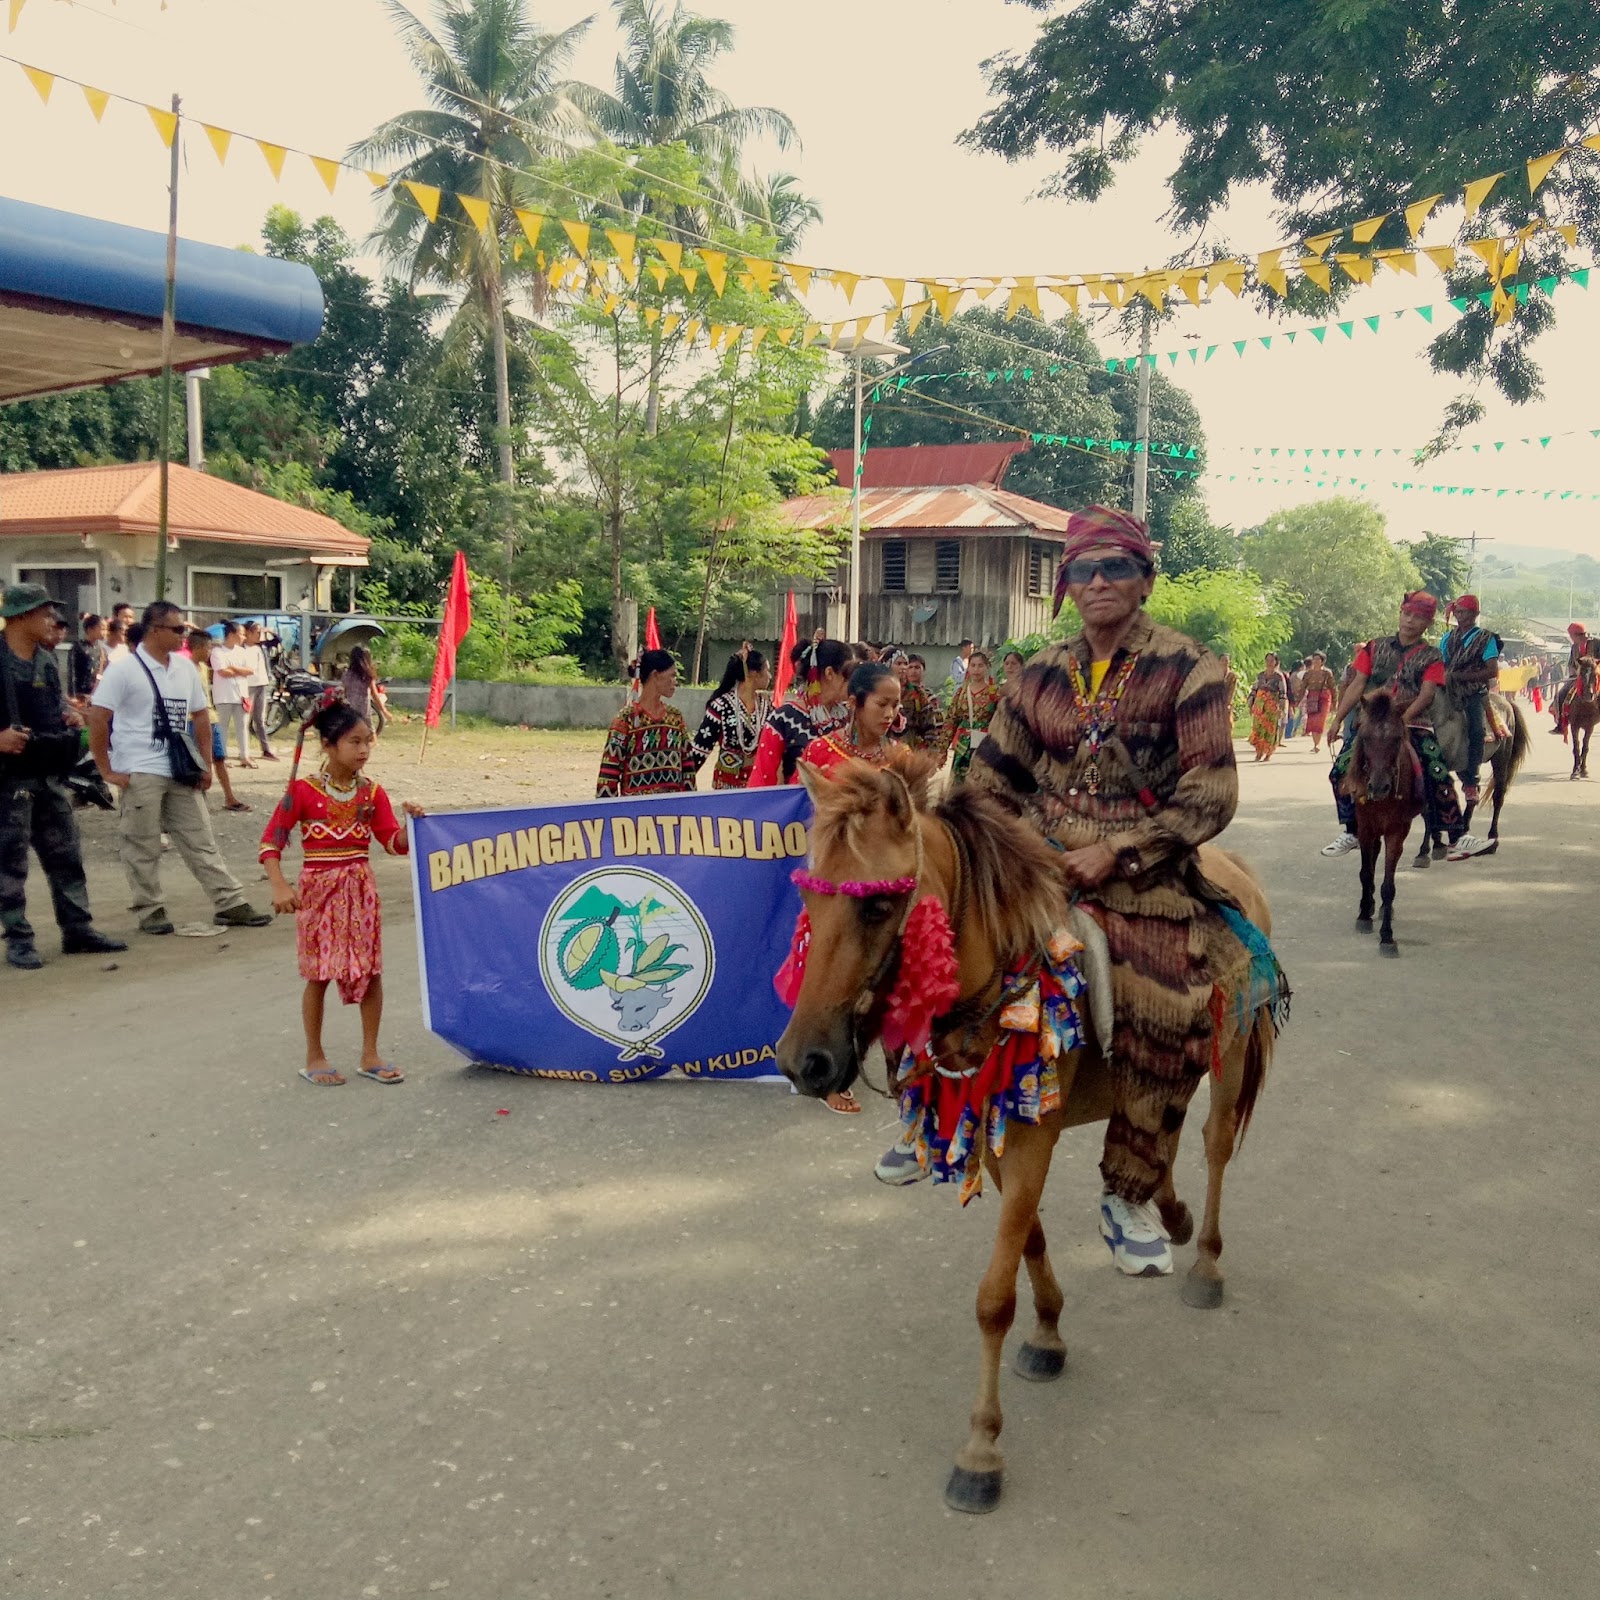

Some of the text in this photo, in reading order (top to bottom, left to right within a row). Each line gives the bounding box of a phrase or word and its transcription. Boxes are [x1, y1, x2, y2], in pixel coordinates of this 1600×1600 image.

[428, 815, 808, 893] BARANGAY DATALBLAO
[608, 1060, 702, 1083] SULAN
[707, 1043, 777, 1073] KUDA
